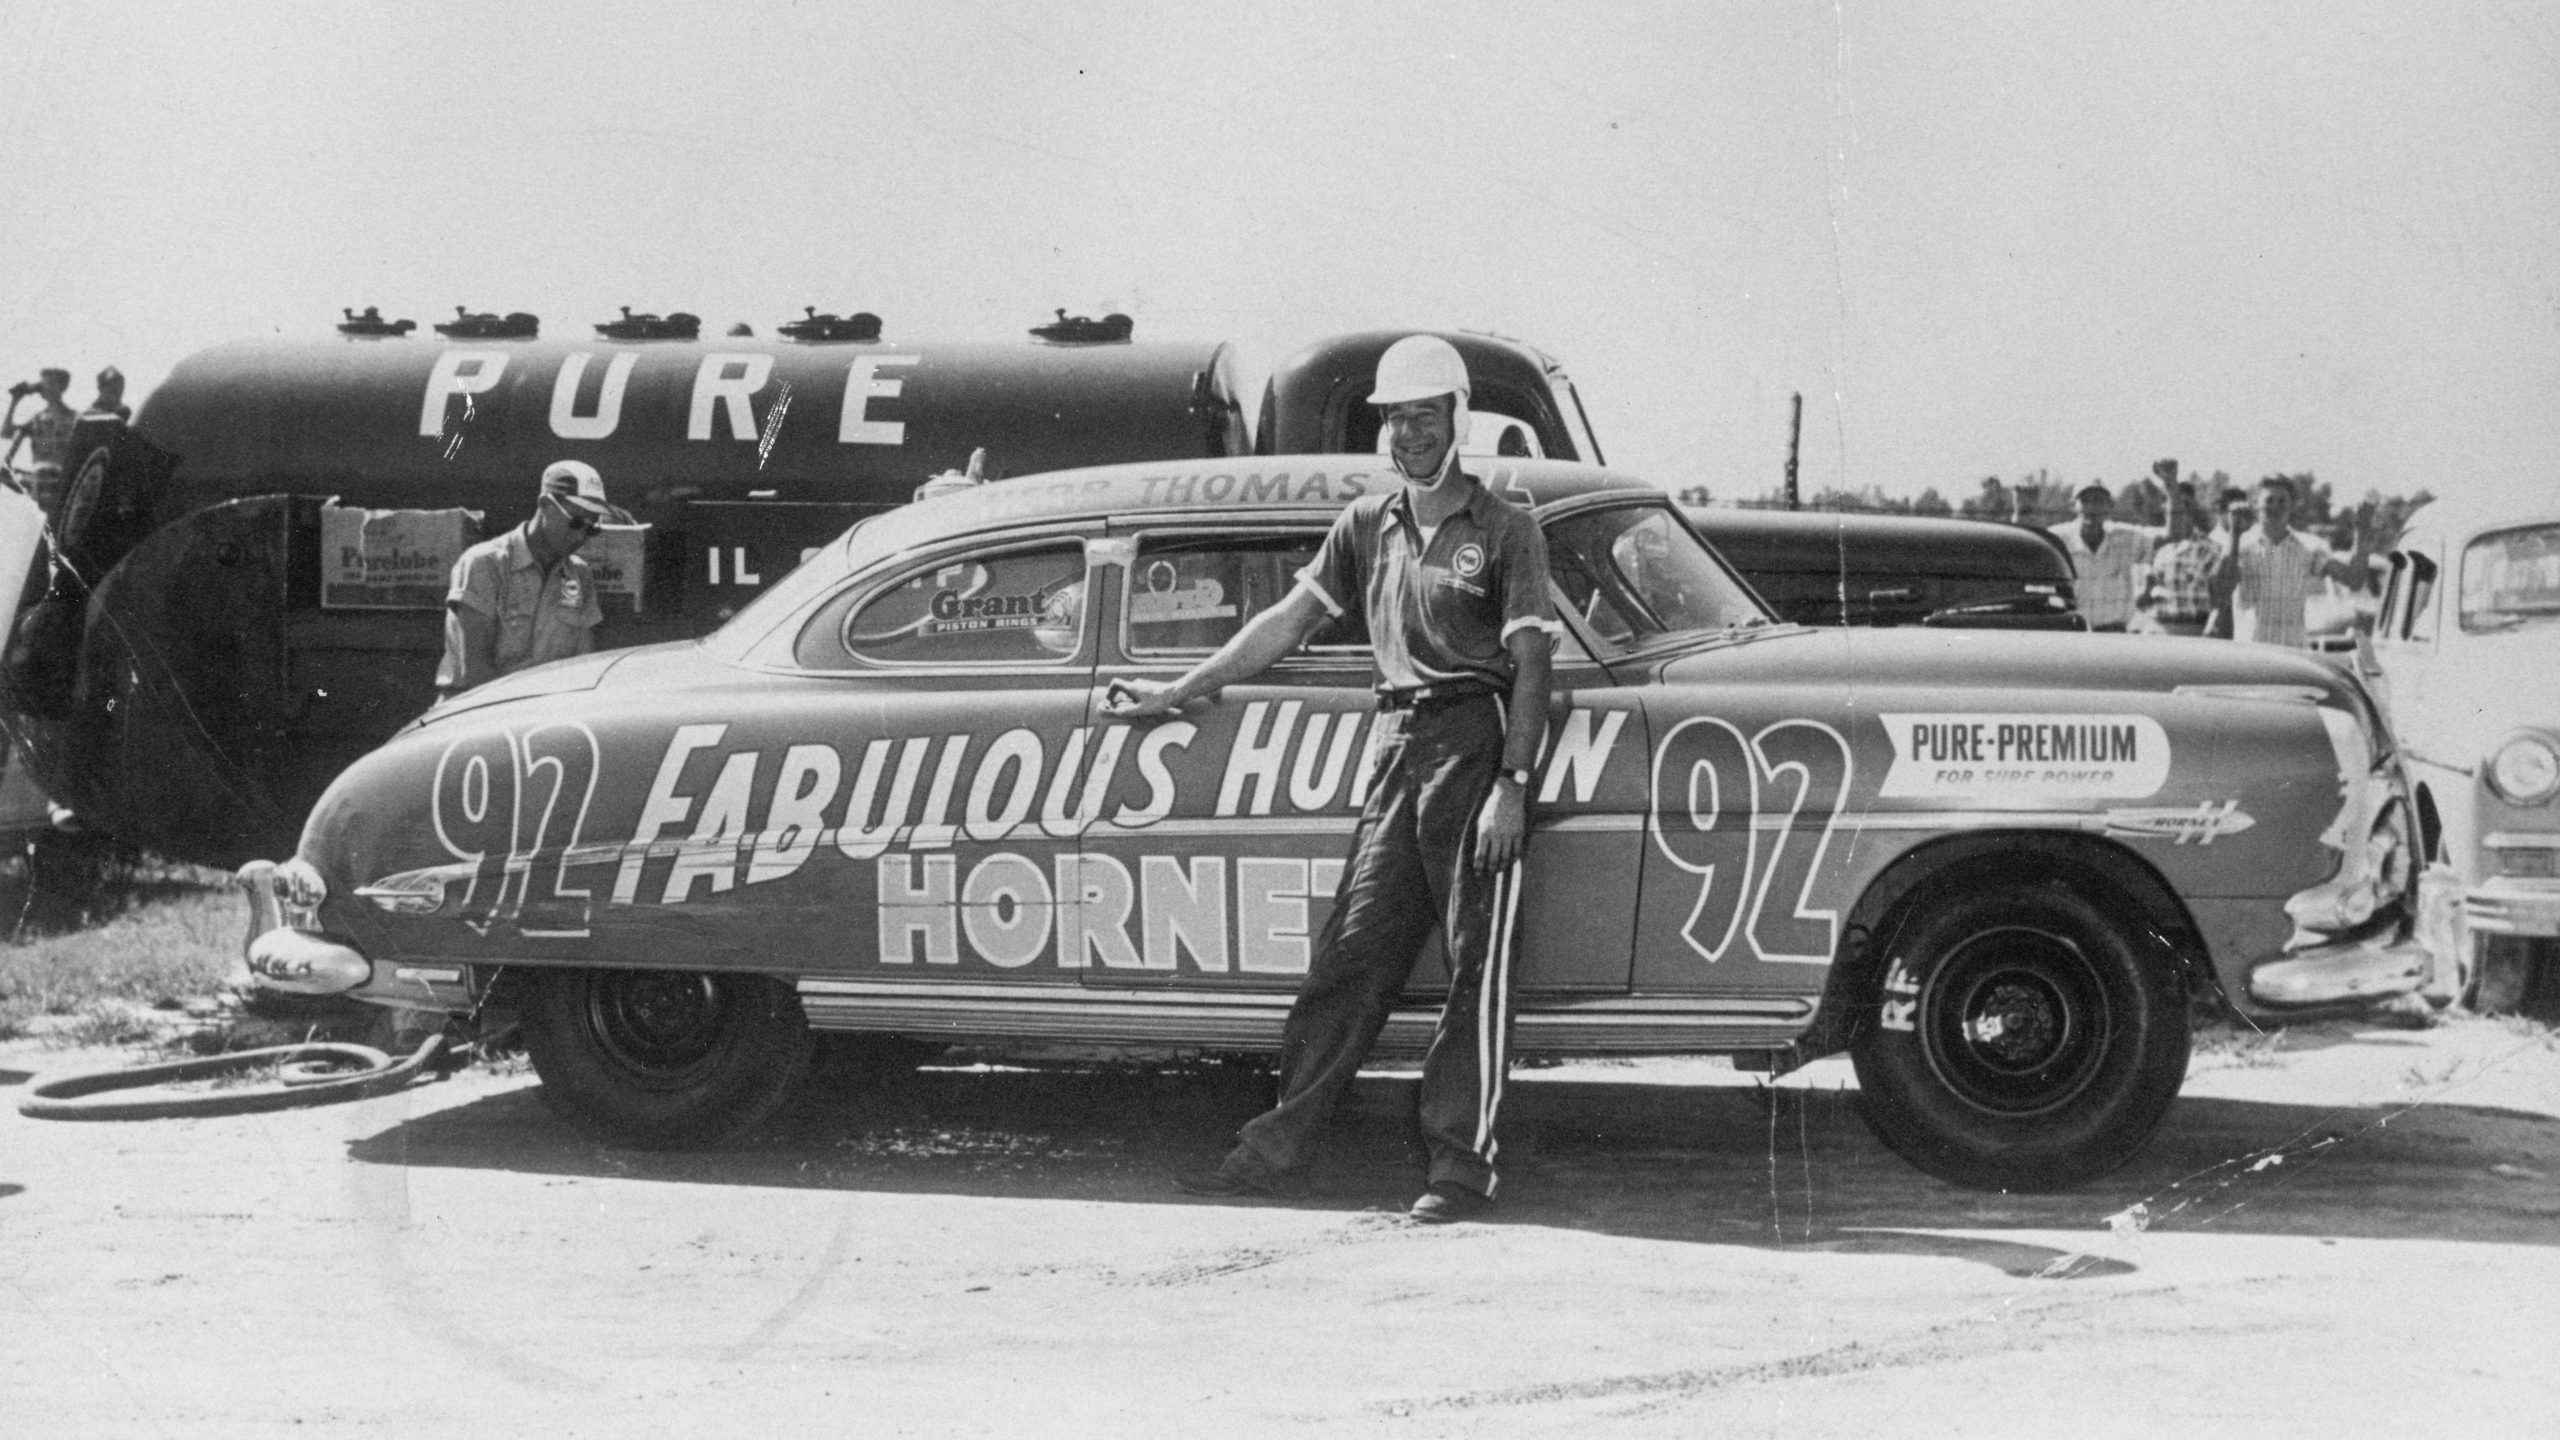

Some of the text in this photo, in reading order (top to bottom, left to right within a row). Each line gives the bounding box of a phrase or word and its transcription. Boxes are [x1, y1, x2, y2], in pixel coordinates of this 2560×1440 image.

[420, 350, 920, 445] PURE
[1139, 471, 1370, 504] THOMAS
[931, 586, 1047, 621] Grant
[937, 616, 1039, 633] PISTON RINGS
[1912, 723, 2137, 763] PURE-PREMIUM
[1934, 769, 1975, 785] FOR
[2041, 769, 2115, 785] POWER
[610, 700, 1629, 904] FABULOUS HUN
[432, 722, 598, 937] 92
[1652, 716, 1853, 965] 92
